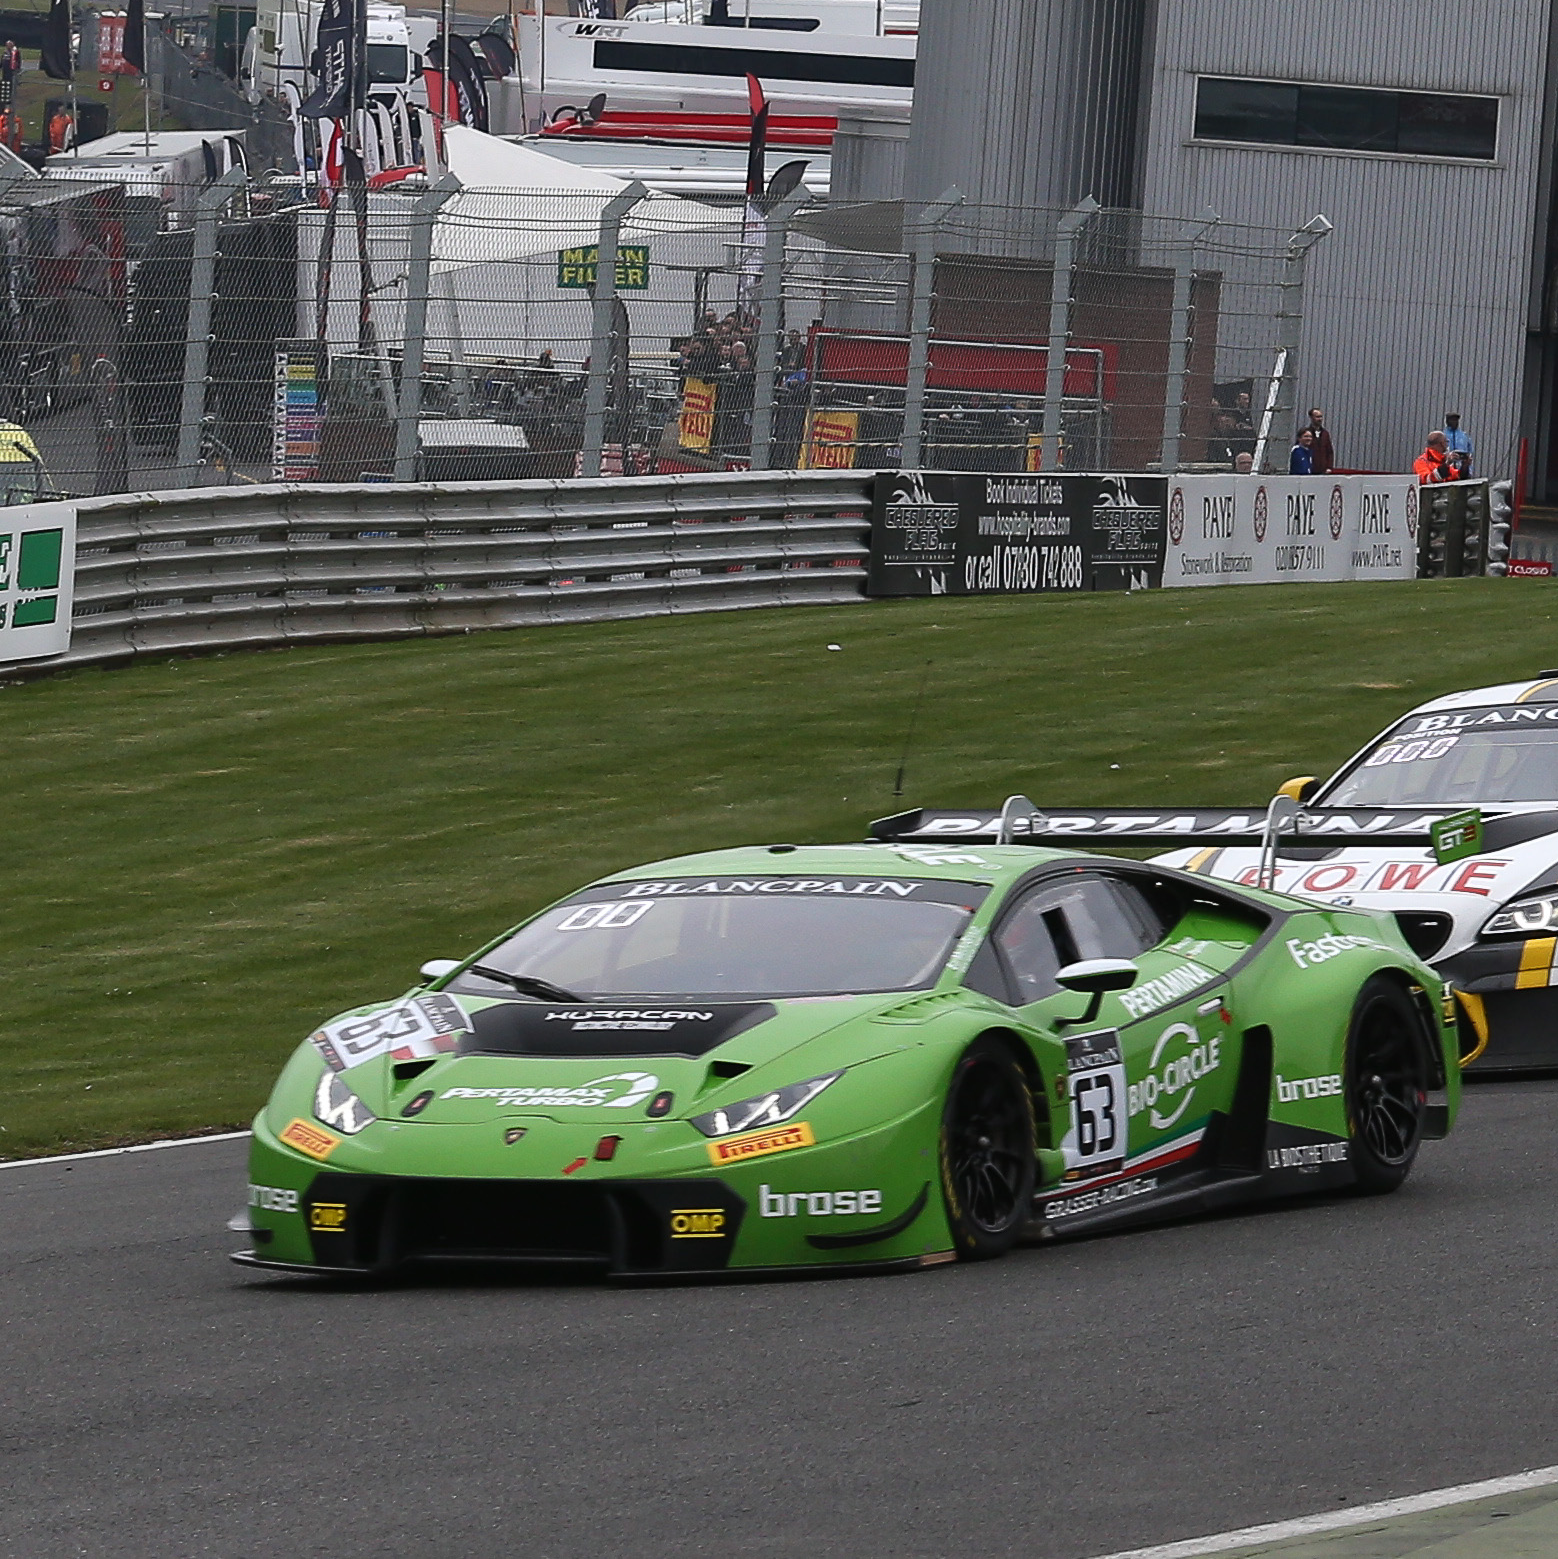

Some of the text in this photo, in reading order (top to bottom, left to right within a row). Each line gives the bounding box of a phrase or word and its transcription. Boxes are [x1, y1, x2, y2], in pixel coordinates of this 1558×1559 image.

[562, 266, 644, 285] FILER
[1202, 494, 1235, 539] PAYE
[1286, 493, 1317, 536] PAYE
[1360, 492, 1392, 534] PAYE
[965, 556, 978, 590] or
[978, 548, 1000, 589] call
[1060, 545, 1083, 589] 888
[1437, 824, 1477, 851] GT3
[620, 879, 925, 900] BLANCPAIN
[1236, 861, 1507, 897] ROWE
[1118, 961, 1216, 1019] PERTAMINA
[439, 1086, 615, 1102] PERTAMAX
[1127, 1036, 1221, 1119] BIO-CIRCLE
[1275, 1073, 1343, 1104] brose
[495, 1095, 607, 1108] TURBO
[1074, 1071, 1114, 1157] 63
[716, 1126, 806, 1160] PIRELLI
[758, 1183, 883, 1218] brose
[670, 1211, 725, 1235] OMP
